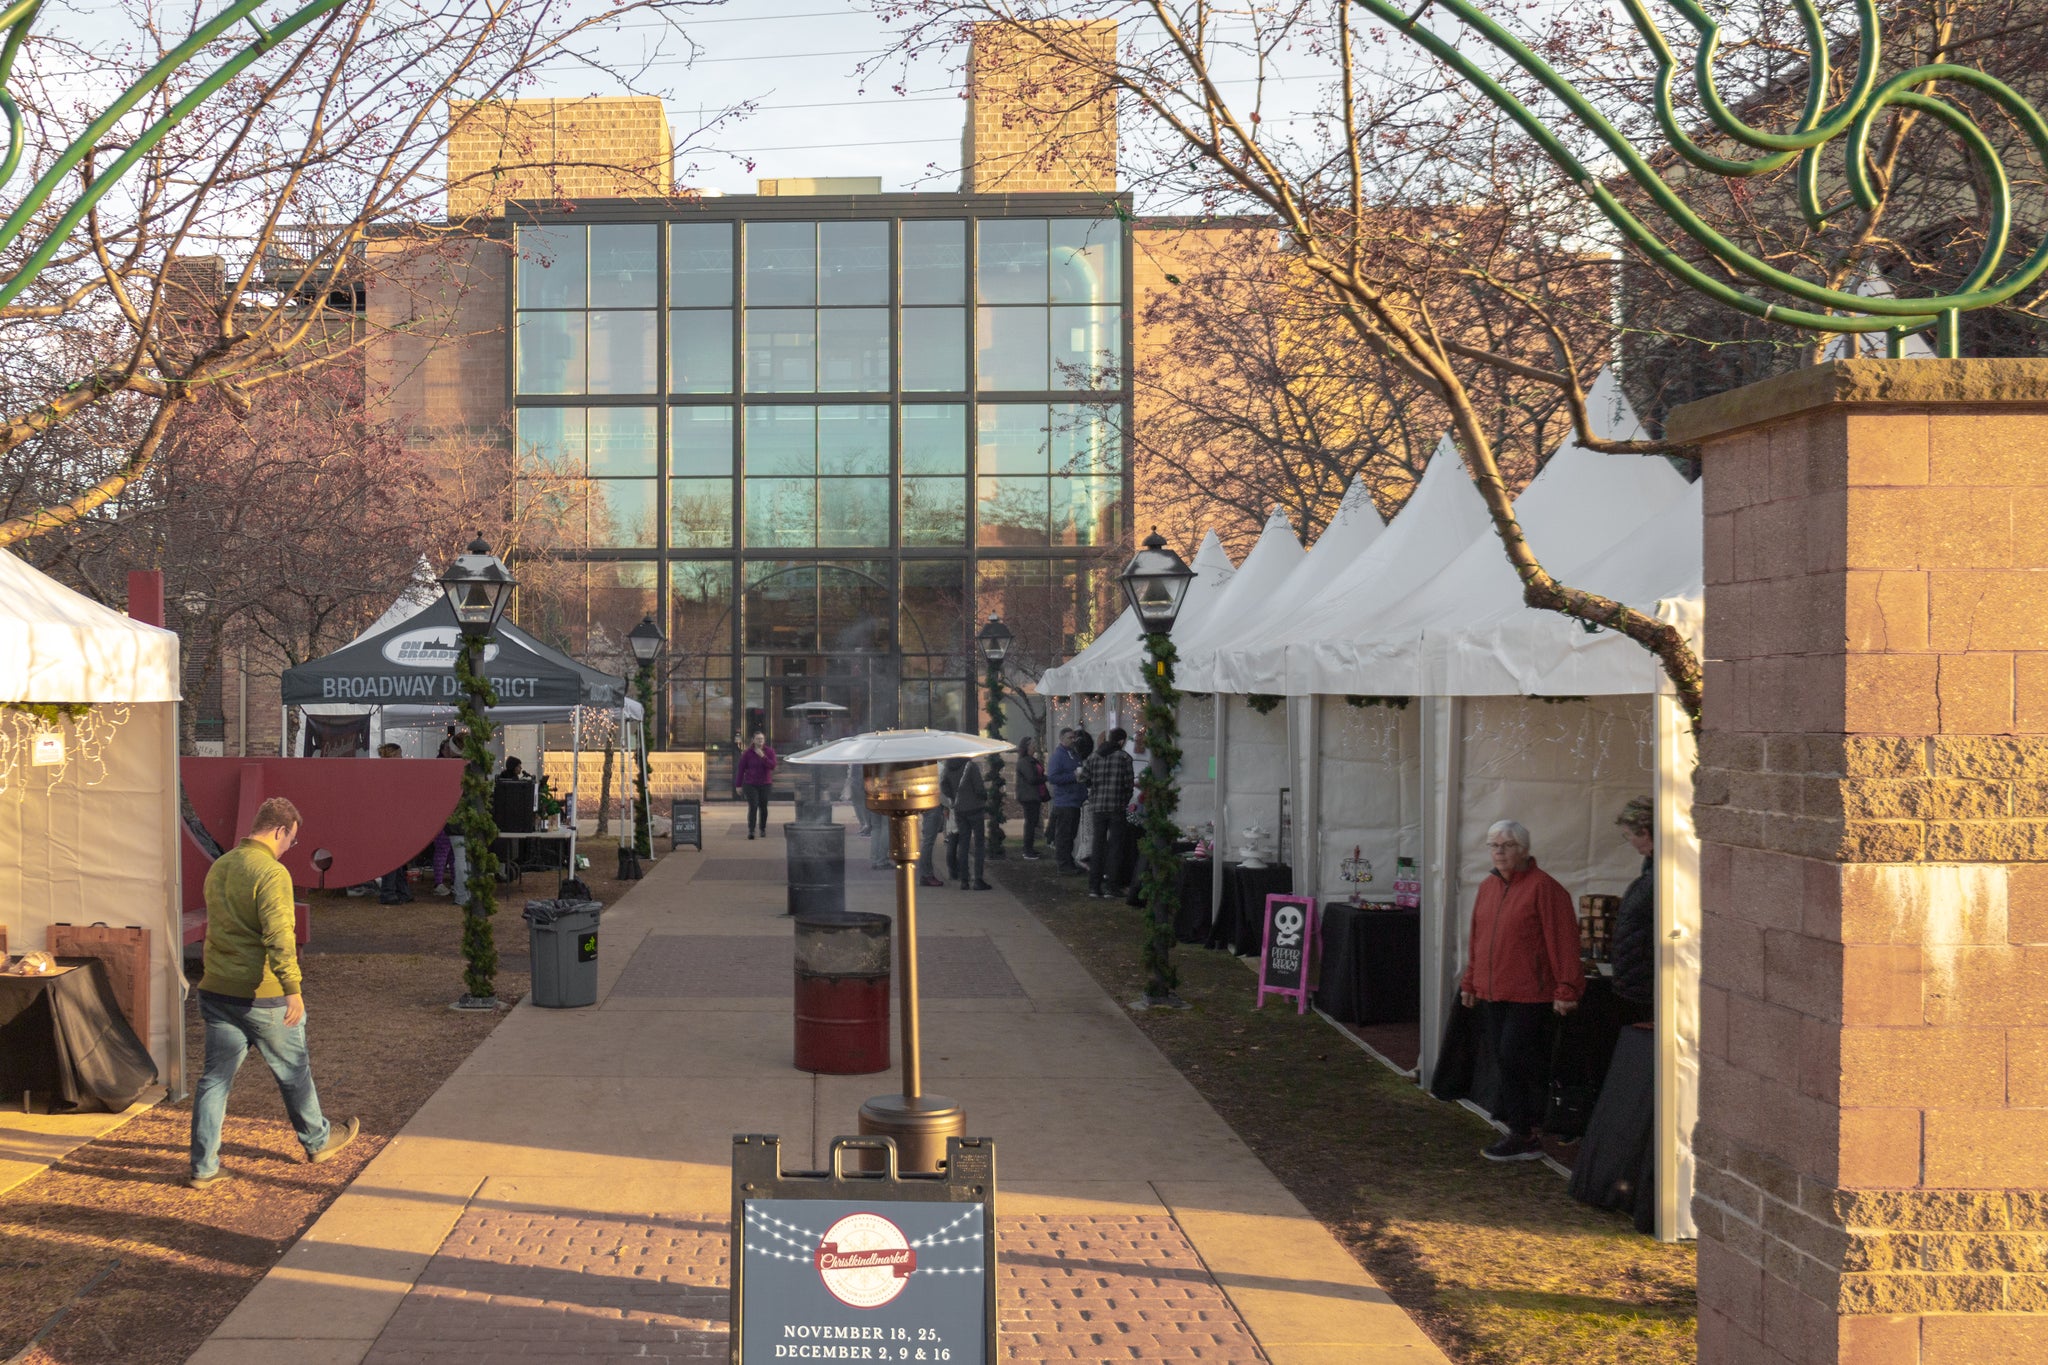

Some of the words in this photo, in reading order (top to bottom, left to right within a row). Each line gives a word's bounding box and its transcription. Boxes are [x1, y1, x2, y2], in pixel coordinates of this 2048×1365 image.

[401, 641, 422, 650] ON
[397, 650, 460, 659] BROADW
[323, 675, 437, 698] BROADWAY
[443, 675, 538, 697] DRICT
[820, 1251, 909, 1269] Christkindlmarket
[784, 1325, 884, 1340] NOVEMBER
[890, 1328, 912, 1342] 18,
[918, 1328, 942, 1342] 25,
[775, 1344, 873, 1359] DECEMBER
[878, 1347, 893, 1361] 2,
[899, 1347, 908, 1360] 9
[915, 1348, 927, 1360] &
[934, 1348, 951, 1361] 16
